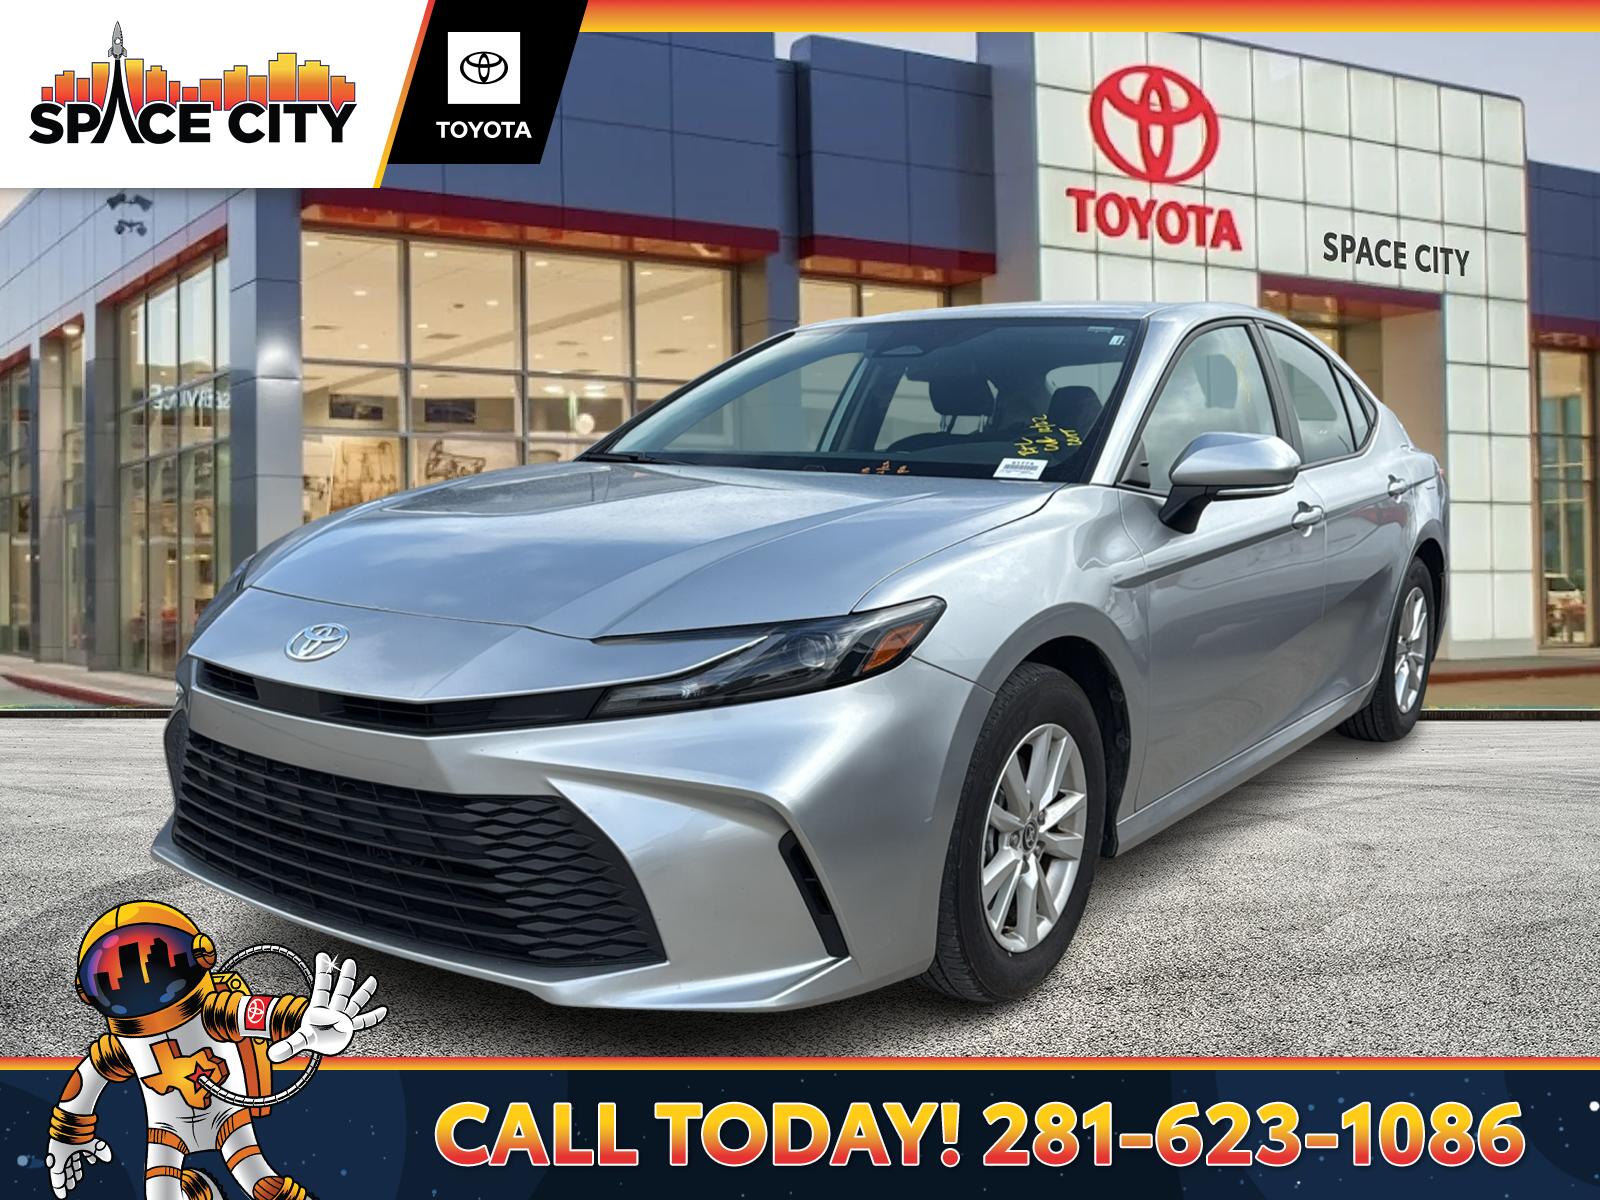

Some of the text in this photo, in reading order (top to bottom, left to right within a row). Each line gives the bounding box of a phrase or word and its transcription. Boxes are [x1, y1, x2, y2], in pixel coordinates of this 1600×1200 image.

[1066, 187, 1242, 251] TOYOTA
[1323, 231, 1471, 277] SPACE CITY
